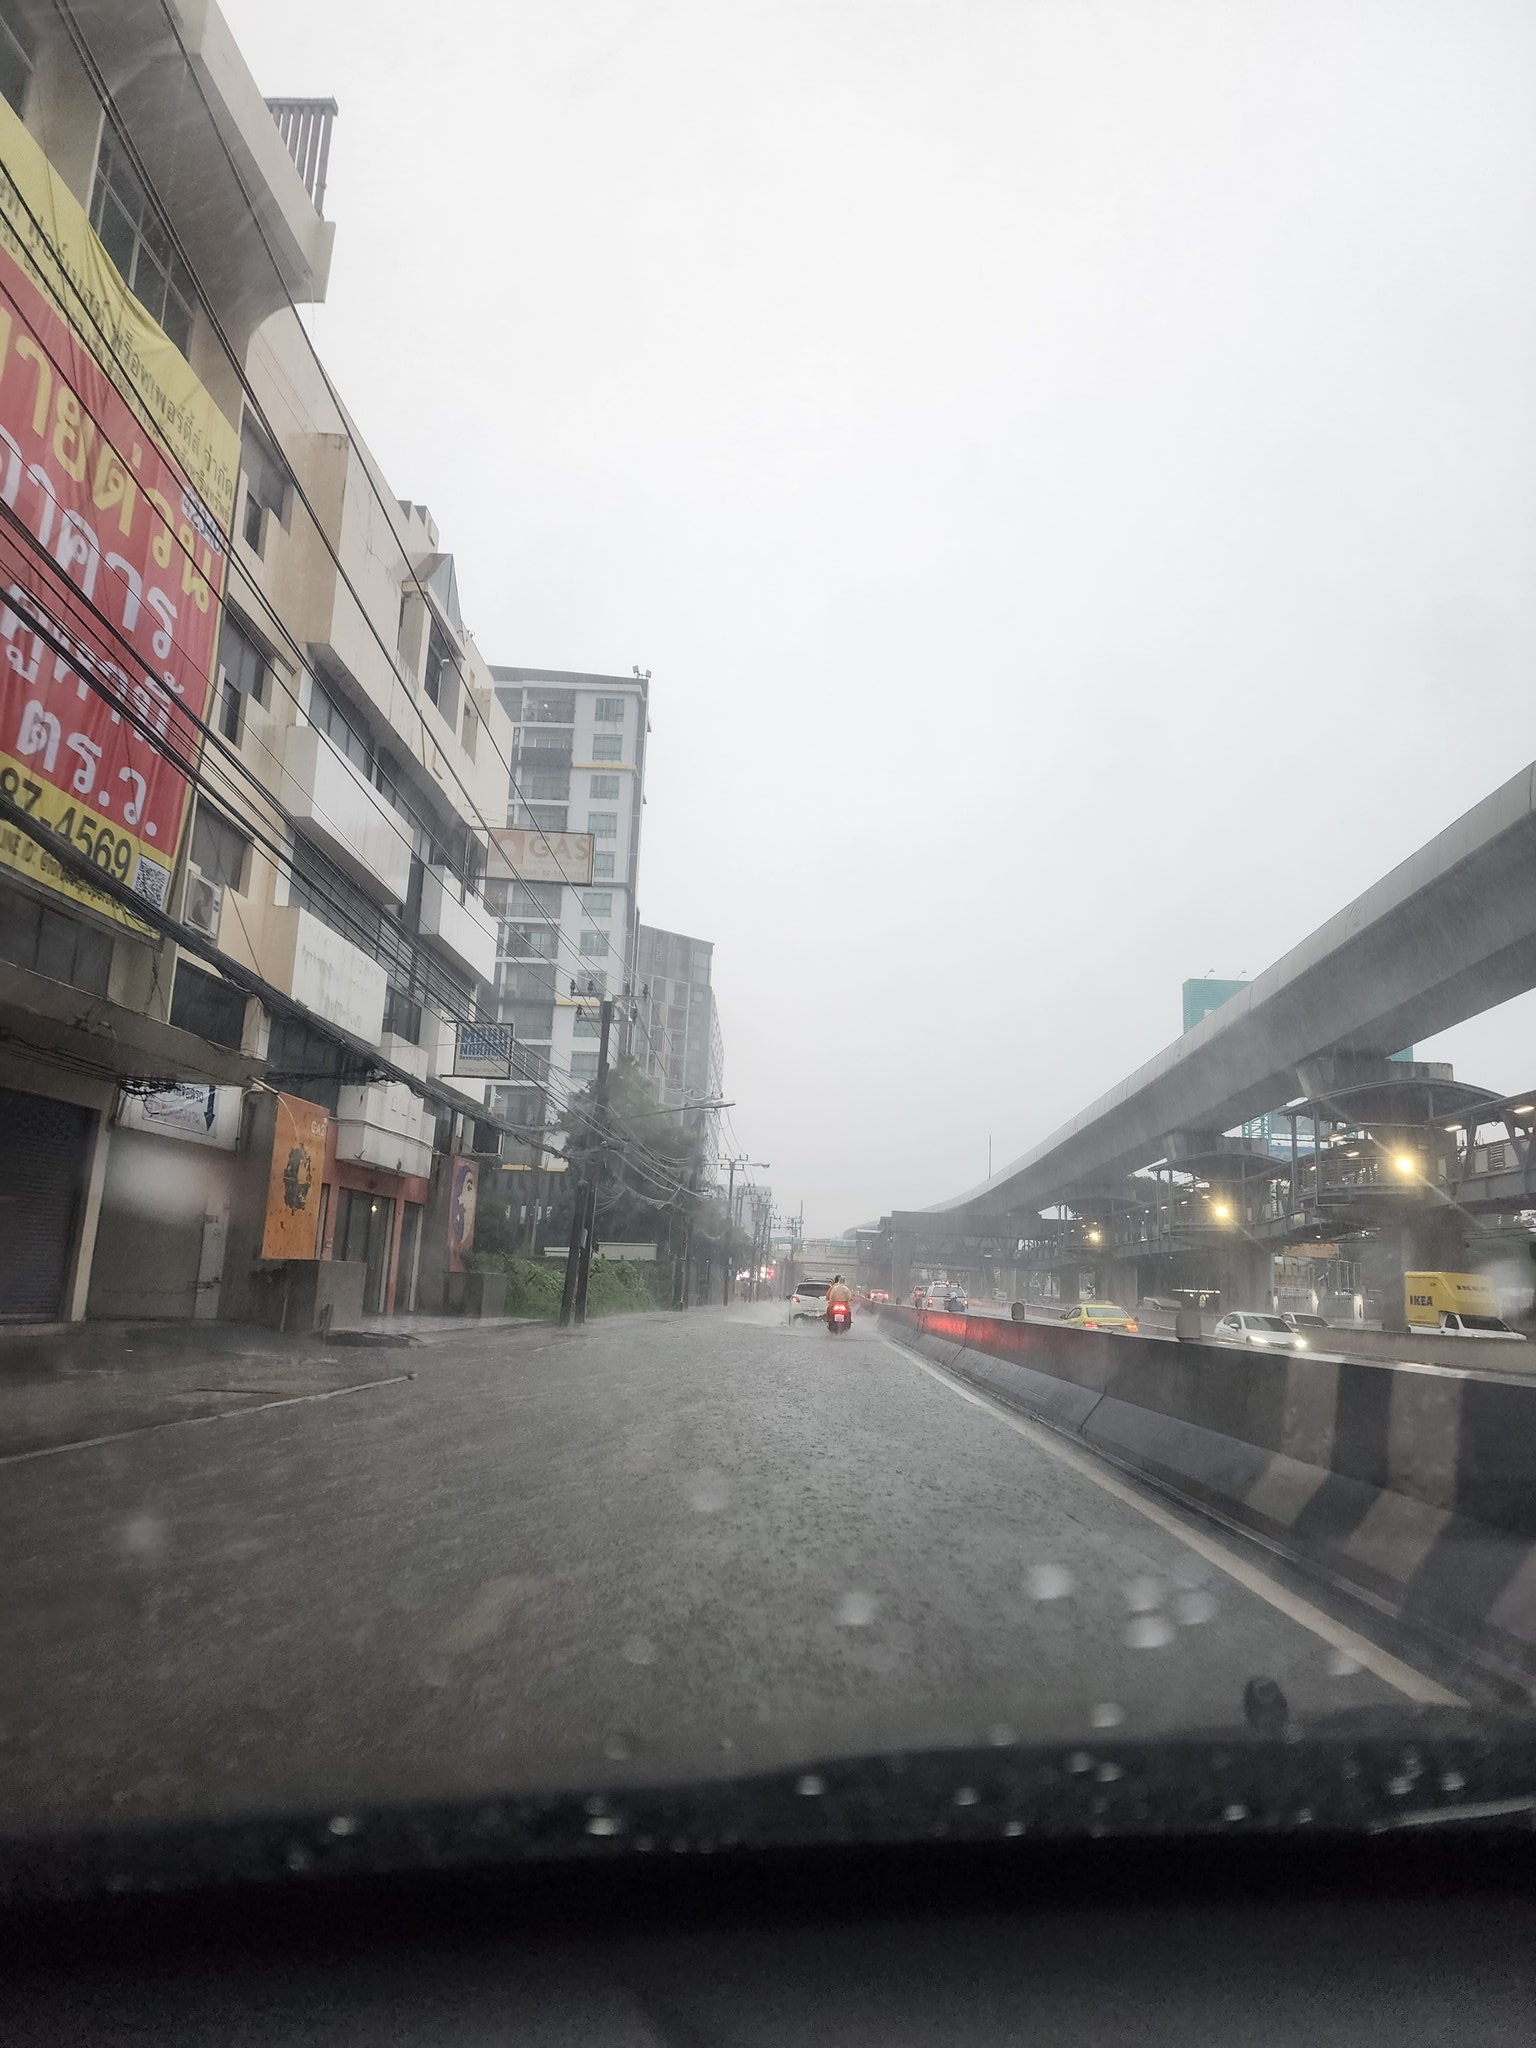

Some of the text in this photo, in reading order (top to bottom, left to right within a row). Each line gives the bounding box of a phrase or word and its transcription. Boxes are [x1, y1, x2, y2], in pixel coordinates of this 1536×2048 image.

[0, 305, 211, 614] ายด่วน
[204, 440, 232, 500] จำกัด
[17, 700, 157, 836] ตร.ว.
[529, 835, 590, 860] GAS
[1410, 1295, 1433, 1306] IKEA
